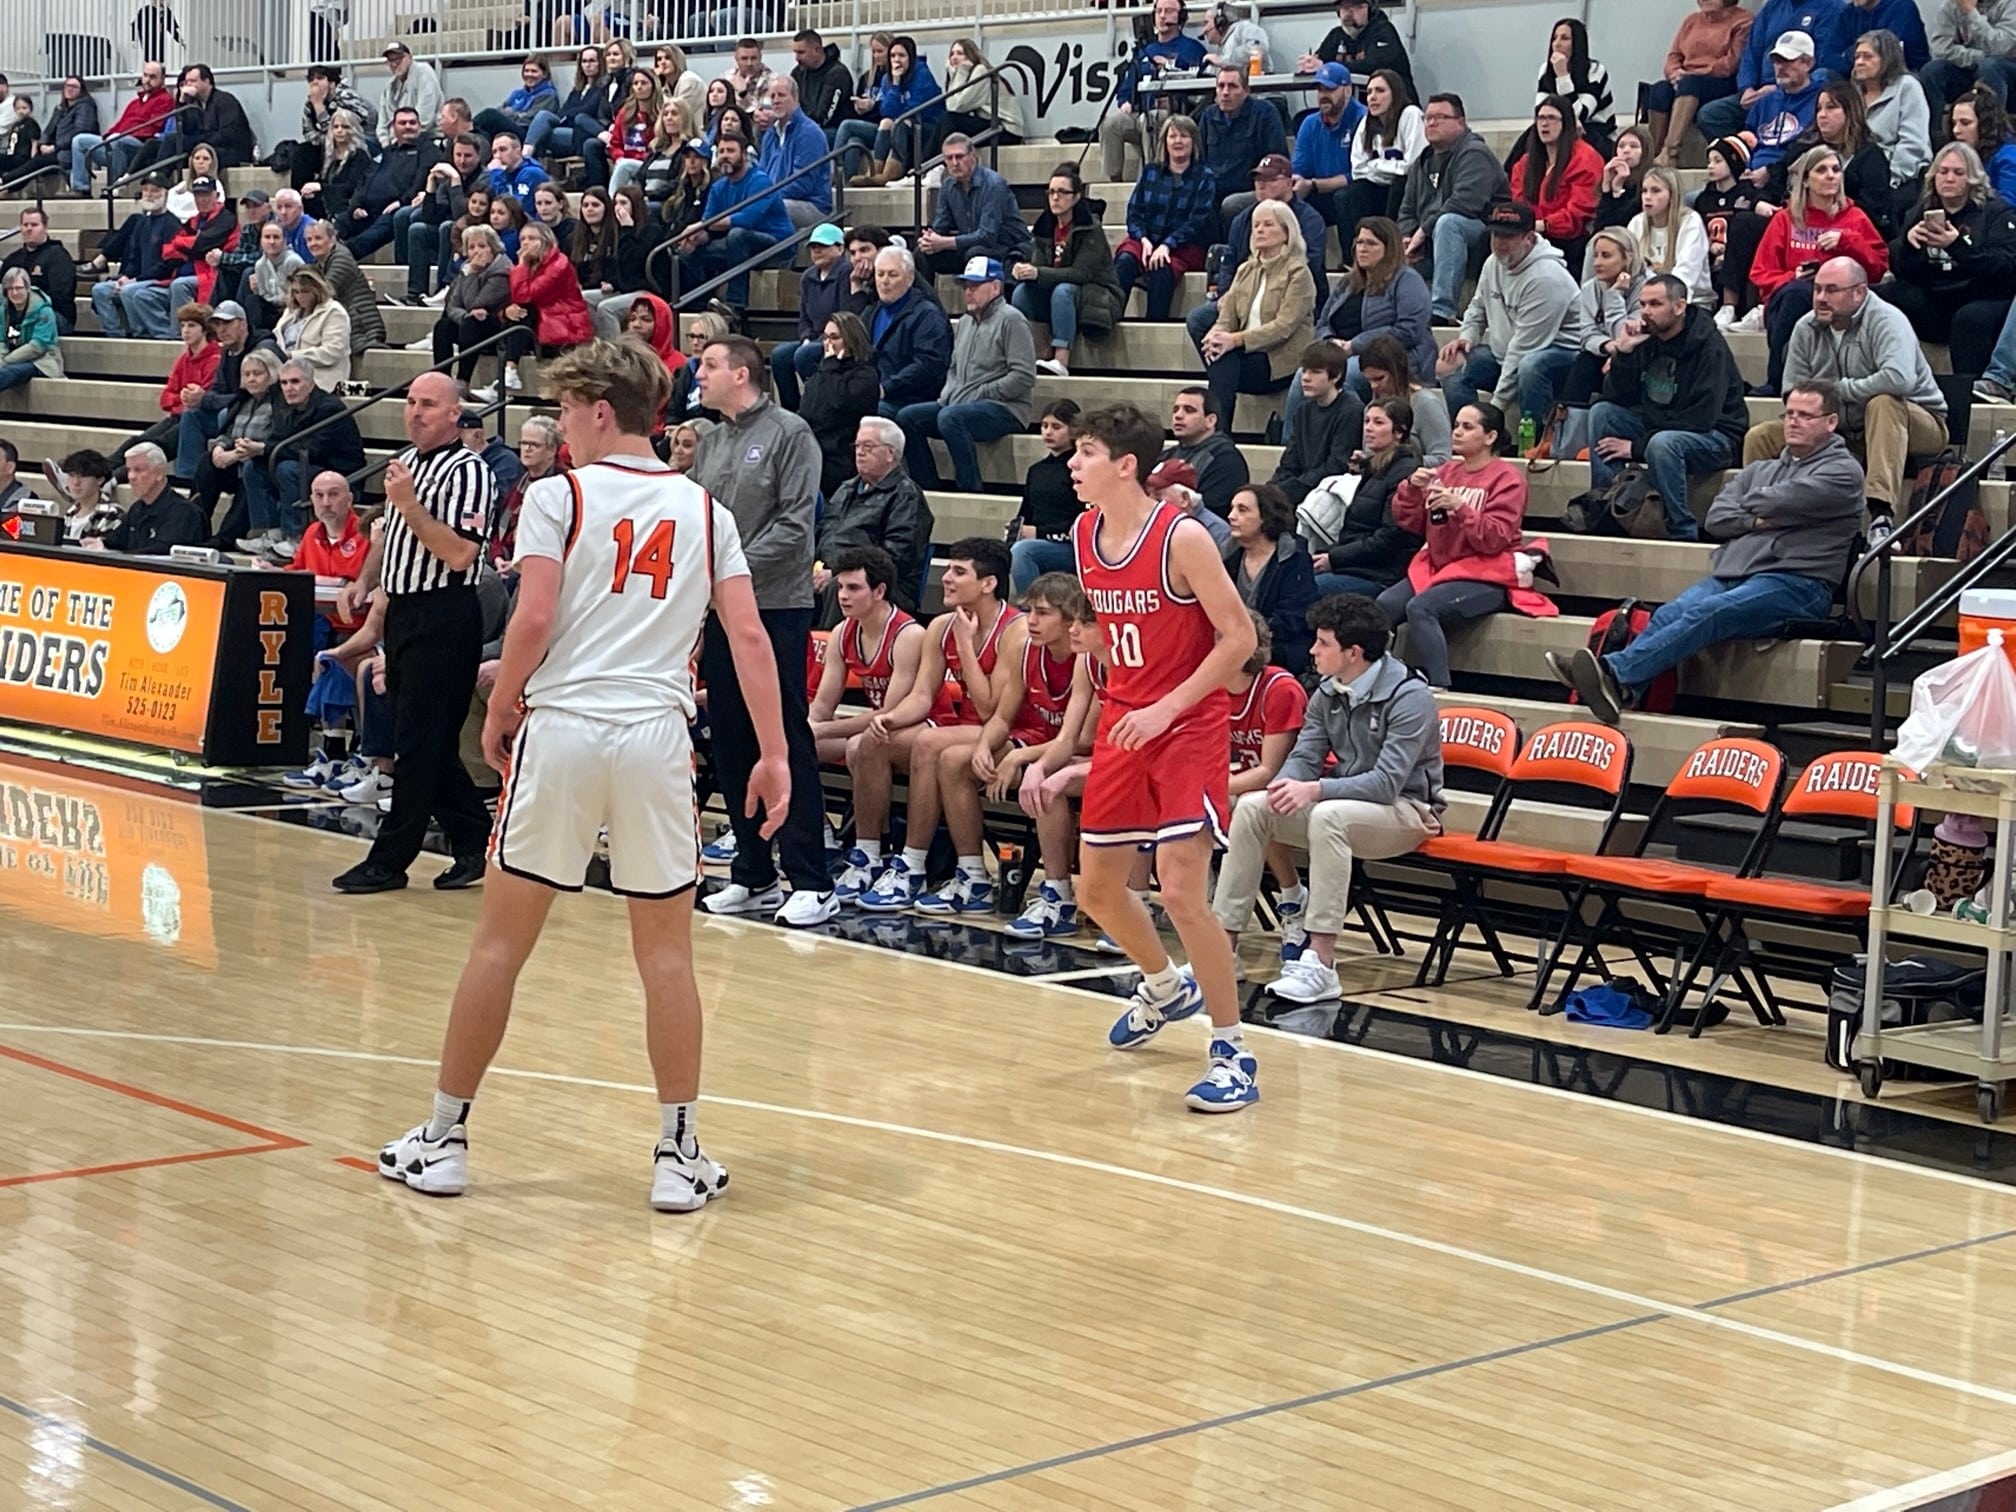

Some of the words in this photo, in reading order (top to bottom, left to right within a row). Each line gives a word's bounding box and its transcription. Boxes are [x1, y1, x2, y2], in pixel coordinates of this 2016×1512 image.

[611, 518, 676, 600] 14
[31, 587, 60, 619] OF
[68, 592, 113, 629] THE
[1108, 622, 1145, 668] 10
[120, 672, 138, 691] Tim
[140, 675, 192, 701] Alexander
[256, 590, 289, 744] RYLE
[126, 696, 177, 721] 525-0123
[1440, 716, 1506, 754] AIDERS
[1527, 730, 1616, 771] RAIDERS
[1686, 748, 1769, 788] RAIDERS
[1805, 761, 1884, 796] RAIDE
